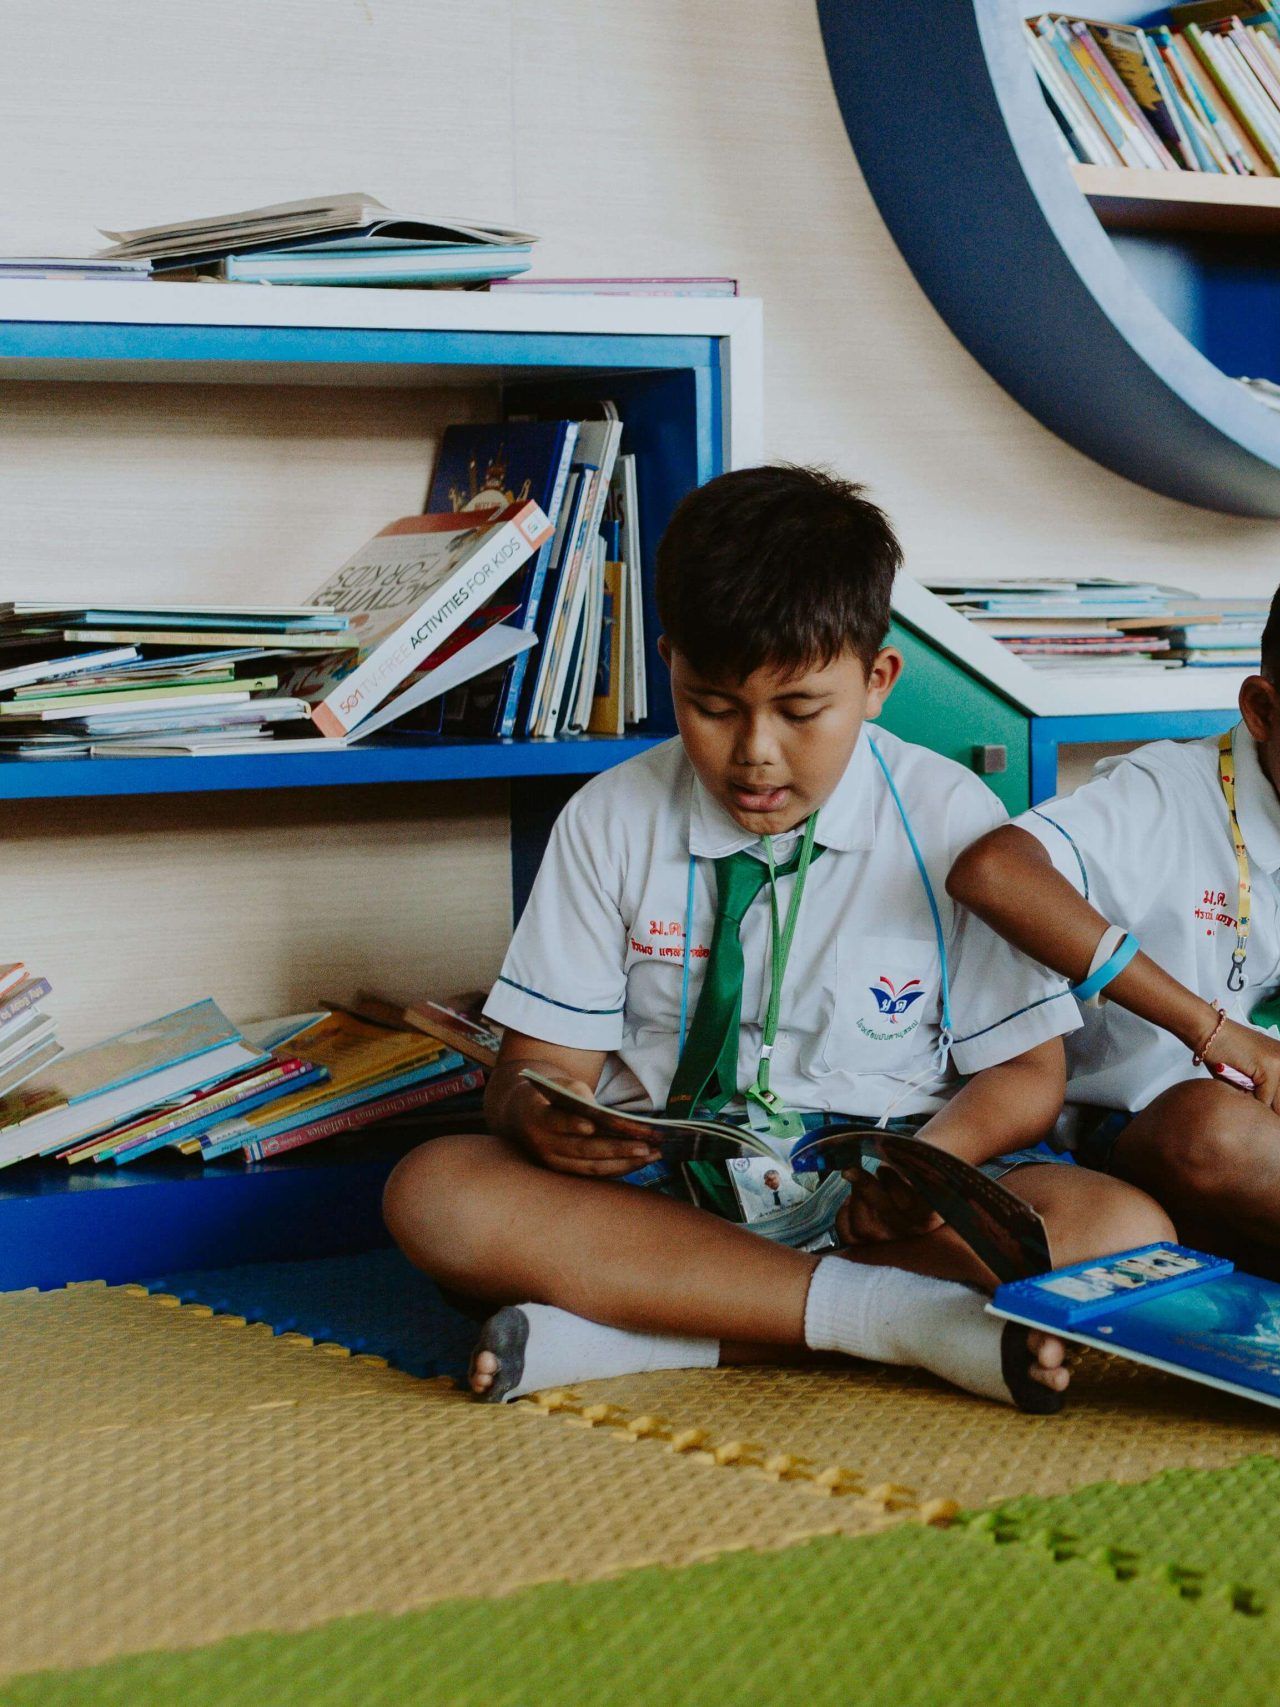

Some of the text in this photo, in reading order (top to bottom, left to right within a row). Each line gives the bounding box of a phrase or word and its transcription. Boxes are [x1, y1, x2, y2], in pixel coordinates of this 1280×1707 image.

[340, 688, 364, 714] 501
[410, 589, 469, 650] ACTIVITIES
[467, 565, 493, 594] FOR
[493, 537, 521, 569] KIDS
